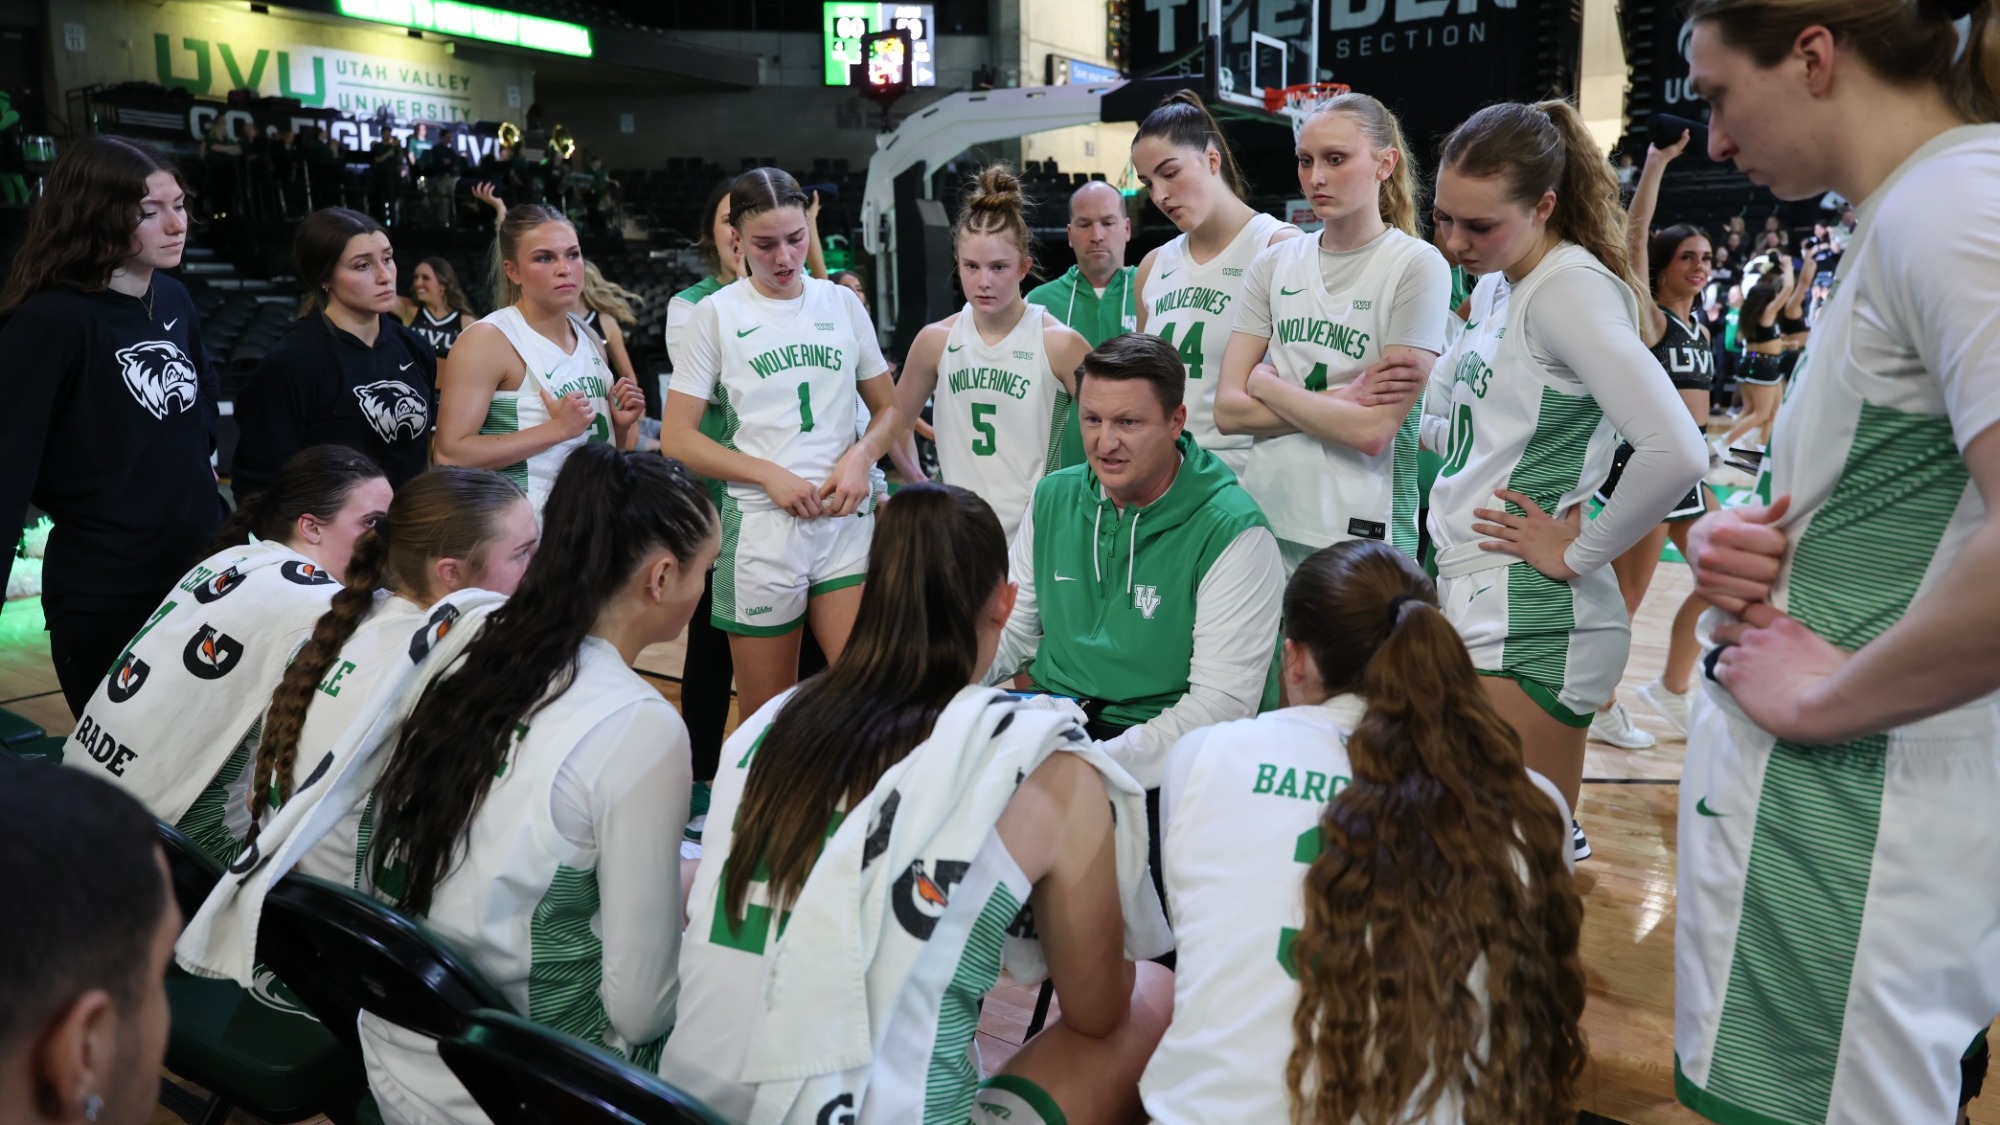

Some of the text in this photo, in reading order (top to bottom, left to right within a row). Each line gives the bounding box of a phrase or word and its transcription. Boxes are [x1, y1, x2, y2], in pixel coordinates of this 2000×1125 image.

[1336, 22, 1485, 59] SECTION
[336, 59, 472, 92] UTAH VALLEY
[338, 93, 472, 122] UNIVERSITY
[1155, 286, 1231, 317] WOLVERINES
[1012, 350, 1034, 360] WAC
[1277, 317, 1380, 360] WOLVERINES
[749, 343, 843, 380] WOLVERINES
[1669, 347, 1715, 374] UV
[948, 367, 1031, 400] WOLVERINES
[797, 381, 815, 433] 1
[971, 402, 997, 457] 5
[193, 565, 247, 604] G
[183, 621, 244, 680] G
[107, 651, 151, 704] G
[893, 859, 972, 942] G
